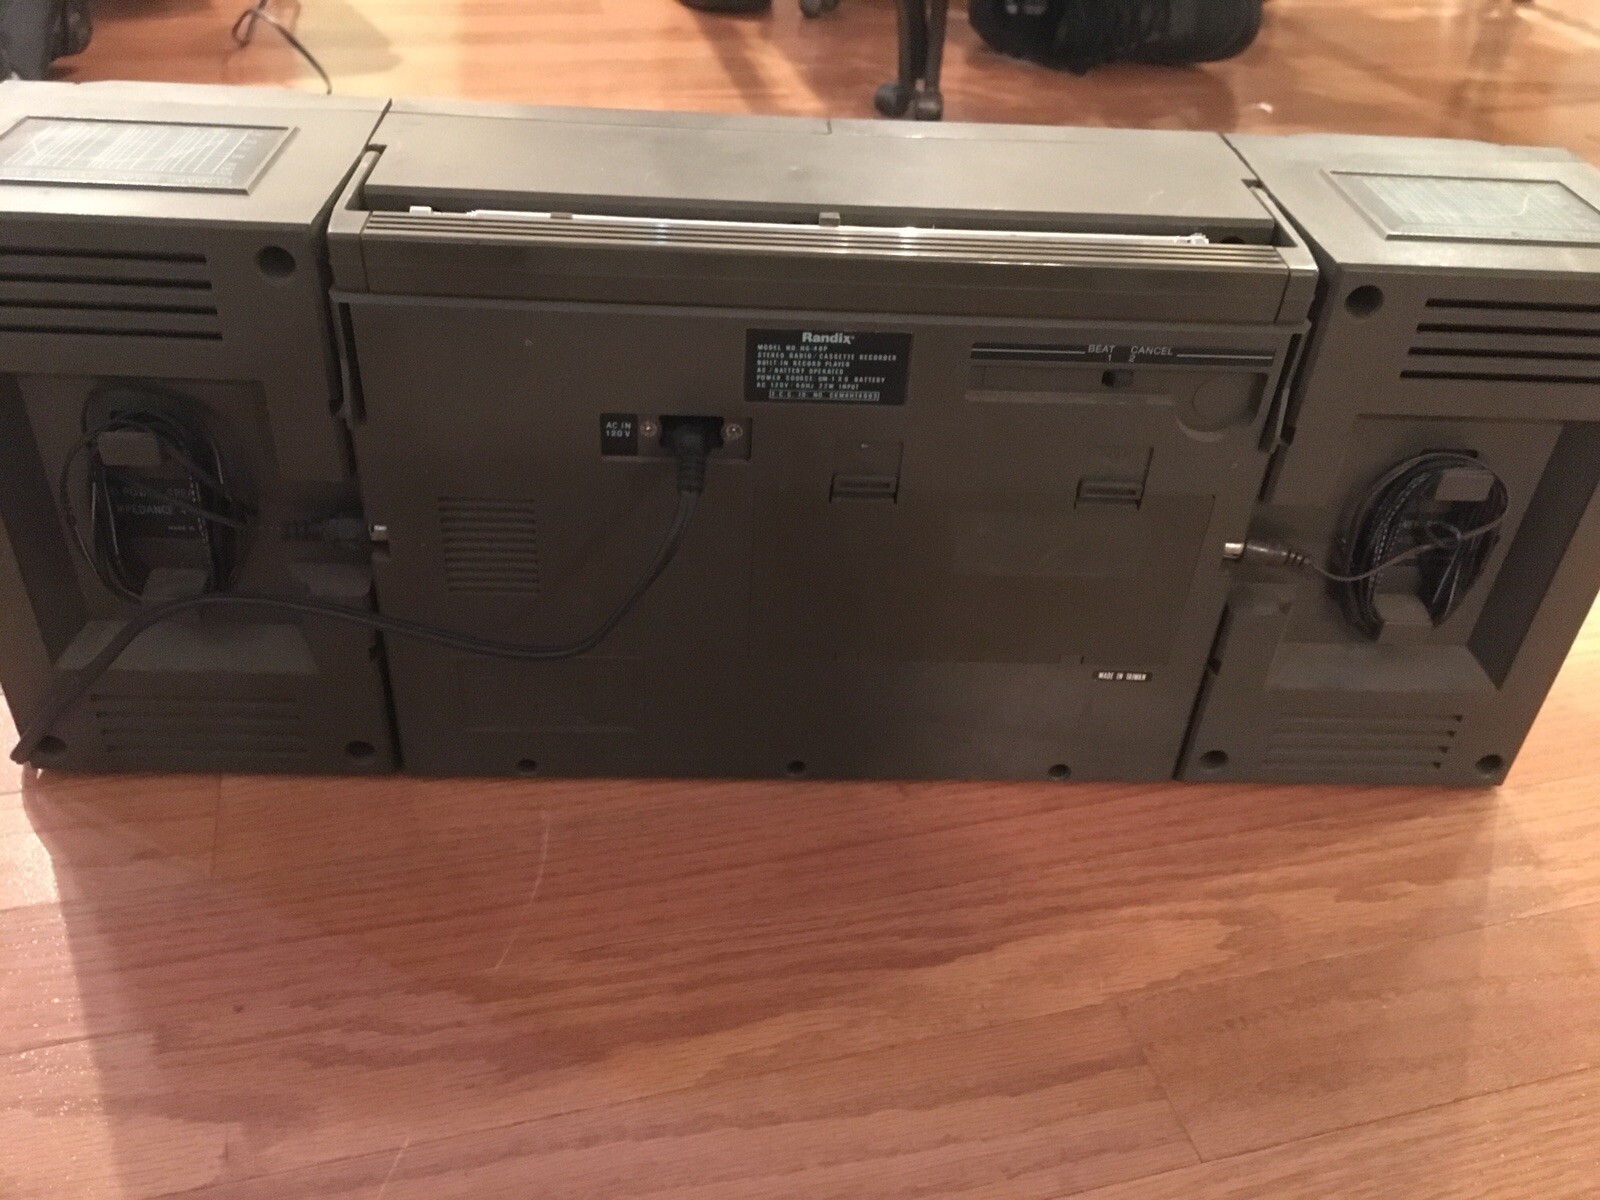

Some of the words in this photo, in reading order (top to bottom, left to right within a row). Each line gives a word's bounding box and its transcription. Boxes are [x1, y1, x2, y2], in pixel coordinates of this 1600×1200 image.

[802, 332, 851, 344] Randix
[1088, 344, 1116, 354] BEAT
[1130, 345, 1174, 356] CANCEL
[1128, 354, 1136, 362] 2
[606, 421, 618, 429] AC
[114, 503, 174, 515] MPEDANCE
